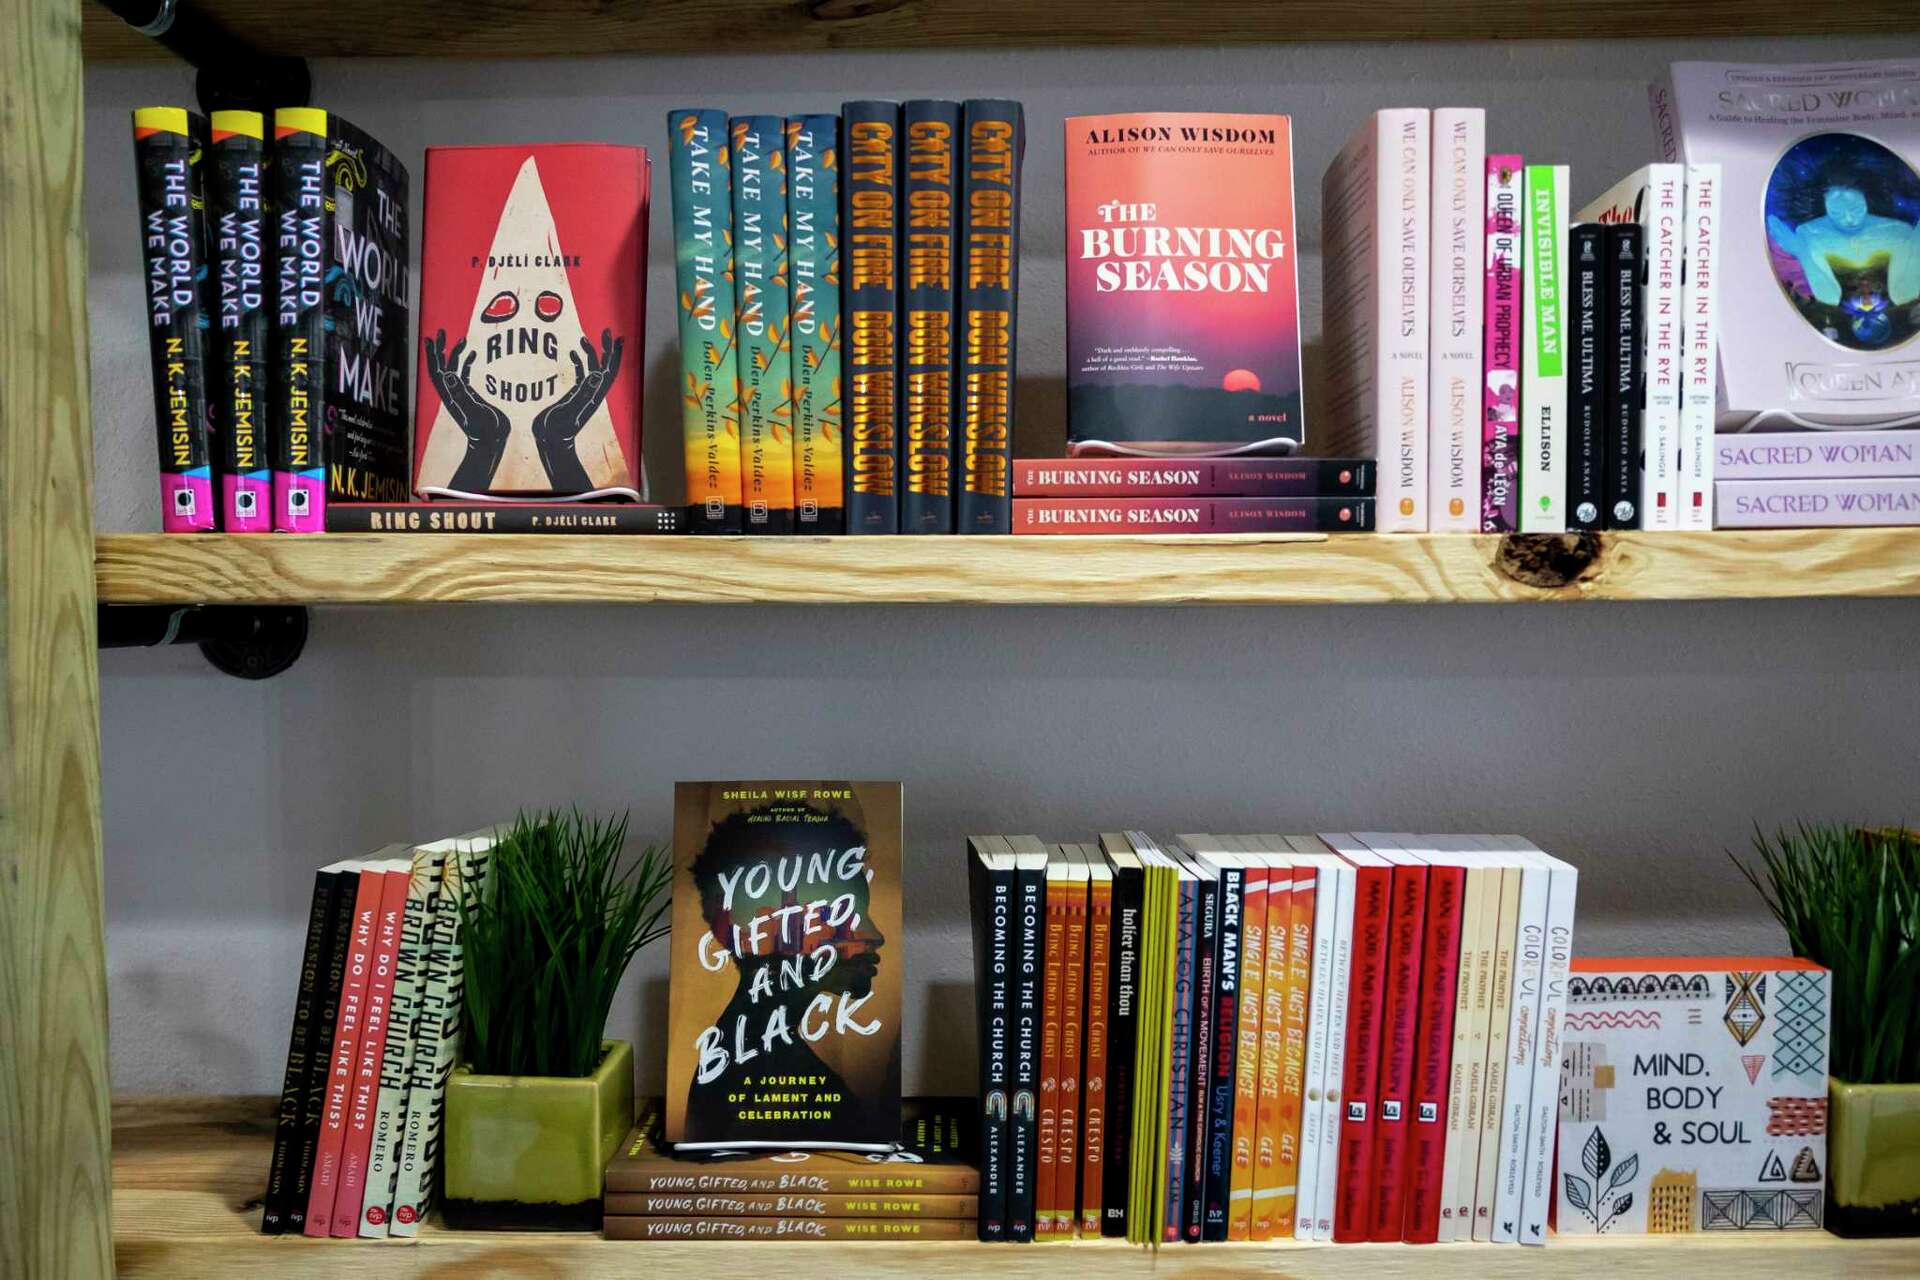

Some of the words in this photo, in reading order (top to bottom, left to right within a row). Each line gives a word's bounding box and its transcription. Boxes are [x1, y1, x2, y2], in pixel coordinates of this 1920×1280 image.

[1086, 127, 1171, 144] ALISON
[1180, 128, 1276, 144] WISDOM
[1403, 121, 1416, 143] WE
[691, 126, 711, 195] TAKE
[742, 133, 760, 201] TAKE
[852, 122, 893, 186] CITY
[1403, 148, 1416, 173] CAN
[164, 160, 187, 207] THE
[239, 163, 259, 210] THE
[300, 161, 320, 207] THE
[1402, 179, 1415, 211] ONLY
[1661, 180, 1674, 207] THE
[147, 210, 165, 248] WE
[280, 210, 297, 247] WE
[376, 188, 402, 238] THE
[693, 206, 712, 246] MY
[852, 191, 893, 228] ON
[1098, 200, 1157, 223] THE
[1496, 193, 1513, 234] QUEEN
[220, 213, 236, 250] WE
[744, 212, 762, 251] MY
[1080, 227, 1285, 259] BURNING
[1402, 218, 1415, 253] SAVE
[1496, 238, 1512, 253] OF
[1536, 189, 1553, 298] INVISIBLE
[1659, 216, 1673, 289] CATCHER
[167, 217, 193, 306] WORLD
[240, 219, 262, 309] WORLD
[300, 217, 321, 306] WORLD
[338, 224, 409, 309] WORLD
[535, 256, 581, 266] CLARK
[852, 234, 893, 290] FIRE
[1096, 259, 1273, 292] SEASON
[1496, 258, 1512, 300] URBAN
[149, 257, 171, 326] MAKE
[220, 260, 239, 328] MAKE
[280, 258, 297, 326] MAKE
[695, 256, 716, 330] HAND
[745, 262, 764, 336] HAND
[1401, 257, 1415, 337] OURSELVES
[1582, 271, 1593, 307] BLESS
[1659, 298, 1670, 314] IN
[355, 297, 383, 345] WE
[853, 311, 893, 365] DON
[1494, 305, 1512, 368] PROPHECY
[1541, 305, 1557, 353] MAN
[1658, 322, 1670, 349] THE
[486, 327, 559, 364] RING
[1582, 338, 1593, 394] ULTIMA
[339, 346, 399, 416] MAKE
[484, 374, 559, 402] SHOUT
[1657, 358, 1670, 385] RYE
[1258, 412, 1286, 422] novel
[1401, 378, 1415, 426] ALISON
[169, 386, 192, 466] JEMISIN
[235, 389, 254, 468] JEMISIN
[290, 386, 311, 466] JEMISIN
[853, 371, 894, 496] WINSLOW
[1495, 426, 1507, 448] AYA
[1541, 406, 1551, 471] ELLISON
[1401, 430, 1414, 488] WISDOM
[1494, 453, 1507, 468] de
[1719, 447, 1813, 465] SACRED
[1819, 444, 1912, 462] WOMAN
[1038, 470, 1122, 485] BURNING
[1128, 470, 1200, 485] SEASON
[370, 512, 421, 530] RING
[430, 512, 496, 529] SHOUT
[582, 516, 617, 526] CLARK
[1038, 508, 1122, 523] BURNING
[1128, 509, 1200, 523] SEASON
[1736, 494, 1828, 514] SACRED
[722, 791, 769, 800] SHEILA
[774, 790, 807, 800] WISE
[814, 790, 852, 799] ROWE
[717, 845, 875, 911] YOUNG,
[1224, 871, 1240, 926] BLACK
[357, 910, 373, 946] WHY
[698, 893, 862, 971] GIFTED,
[993, 885, 1007, 974] BECOMING
[1122, 908, 1137, 947] holier
[1203, 893, 1214, 938] SEGURA
[394, 899, 424, 984] BROWN
[1175, 893, 1193, 994] ANALOG
[1221, 932, 1239, 991] MAN'S
[1246, 925, 1262, 981] SINGLE
[352, 953, 365, 976] DO
[748, 944, 838, 1003] AND
[1120, 951, 1135, 982] than
[1202, 958, 1212, 992] BIRTH
[343, 995, 359, 1033] FEEL
[992, 981, 1005, 1009] THE
[1118, 985, 1133, 1016] thou
[1201, 996, 1209, 1008] OF
[1201, 1010, 1208, 1018] A
[1241, 988, 1259, 1030] JUST
[378, 995, 412, 1091] CHURCH
[696, 991, 882, 1084] BLACK
[992, 1018, 1004, 1082] CHURCH
[1197, 1020, 1209, 1086] MOVEMENT
[1217, 996, 1234, 1077] RELIGION
[336, 1040, 352, 1077] LIKE
[1169, 1007, 1190, 1130] CHRISTIAN
[1238, 1030, 1258, 1099] BECAUSE
[1632, 1053, 1711, 1077] MIND.
[728, 1094, 746, 1102] OF
[755, 1093, 809, 1103] LAMENT
[815, 1094, 842, 1102] AND
[744, 1077, 752, 1085] A
[760, 1076, 828, 1085] JOURNEY
[1214, 1086, 1228, 1117] Usry
[1646, 1085, 1724, 1110] BODY
[328, 1084, 345, 1130] THIS?
[738, 1111, 832, 1120] CELEBRATION
[1214, 1119, 1222, 1127] &
[373, 1111, 390, 1173] ROMERO
[1088, 1108, 1101, 1162] CRESPO
[1212, 1131, 1226, 1177] Keener
[1236, 1135, 1250, 1166] GEE
[1652, 1121, 1672, 1145] &
[1680, 1121, 1752, 1145] SOUL
[989, 1126, 998, 1194] ALEXANDER
[650, 1176, 696, 1190] YOUNG,
[751, 1179, 776, 1189] AND
[779, 1174, 829, 1191] BLACK
[848, 1179, 880, 1188] WISE
[886, 1179, 924, 1188] ROWE
